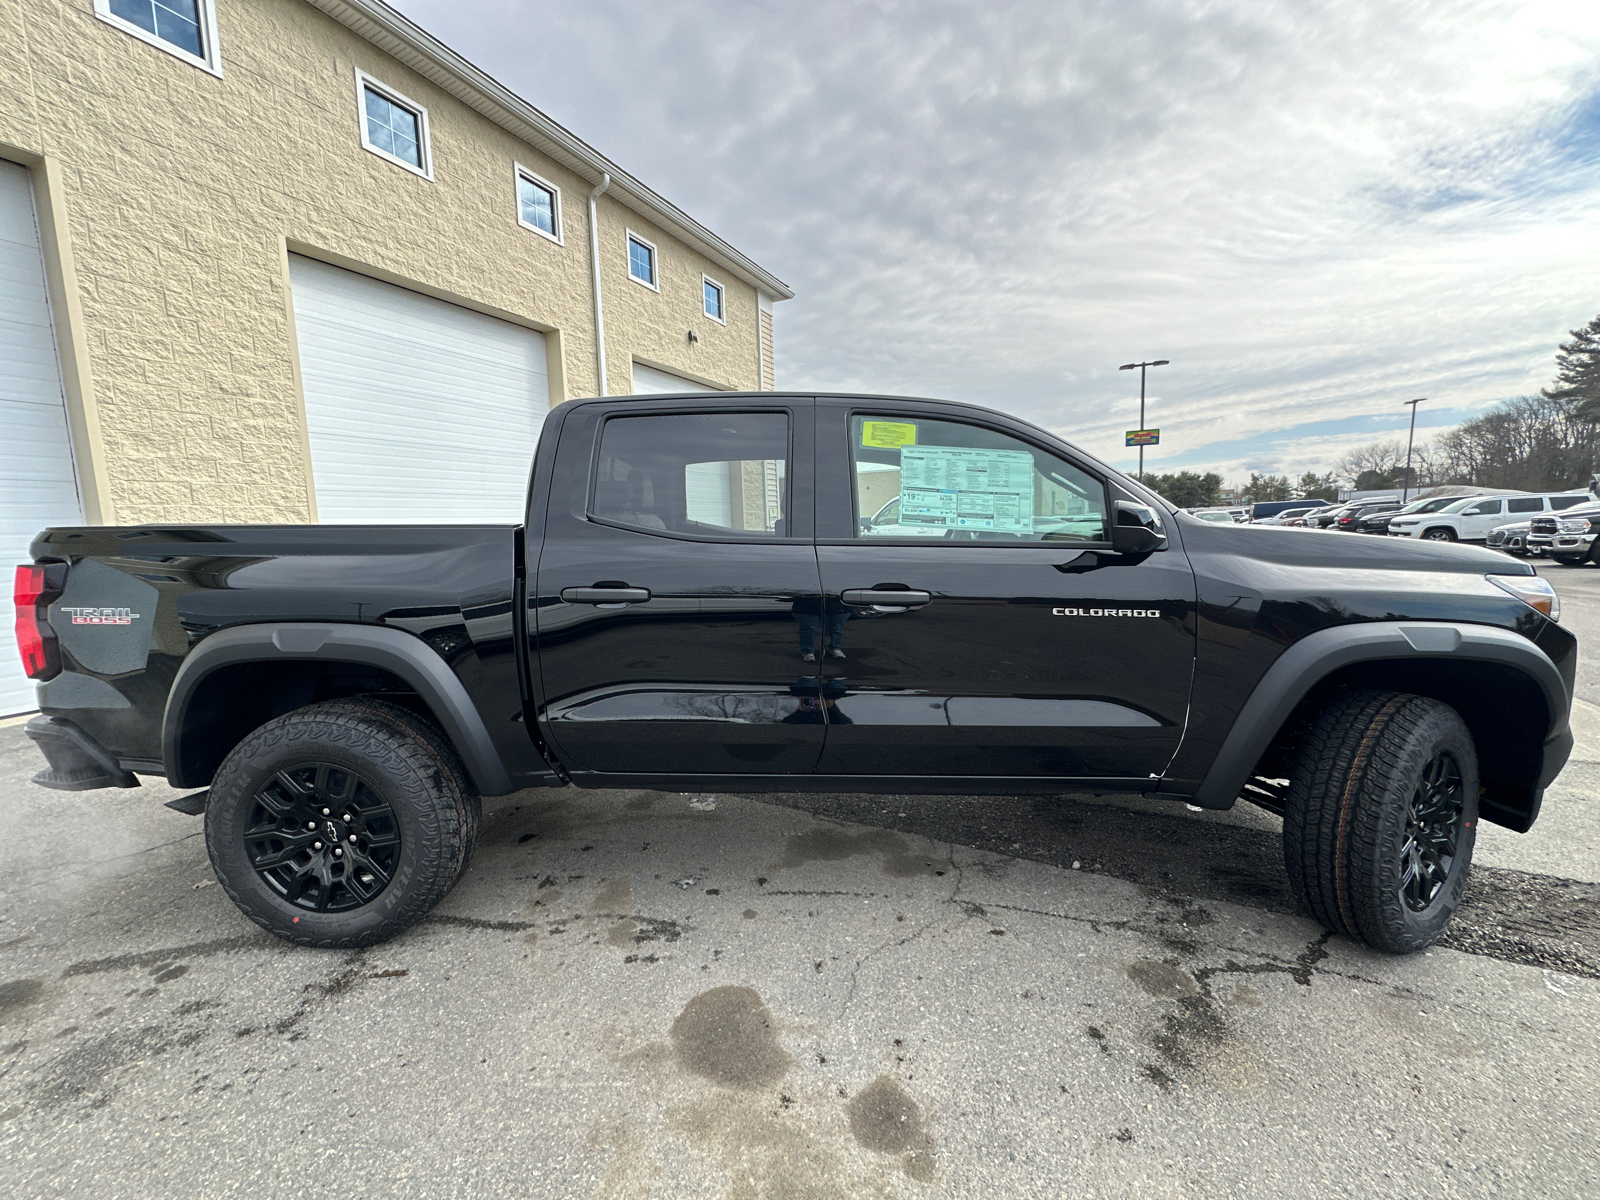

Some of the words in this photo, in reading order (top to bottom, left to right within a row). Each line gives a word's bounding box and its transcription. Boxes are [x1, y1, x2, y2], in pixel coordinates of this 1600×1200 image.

[61, 607, 140, 618] TRAIL
[1052, 602, 1160, 618] COLORADO
[72, 616, 131, 624] BOSS
